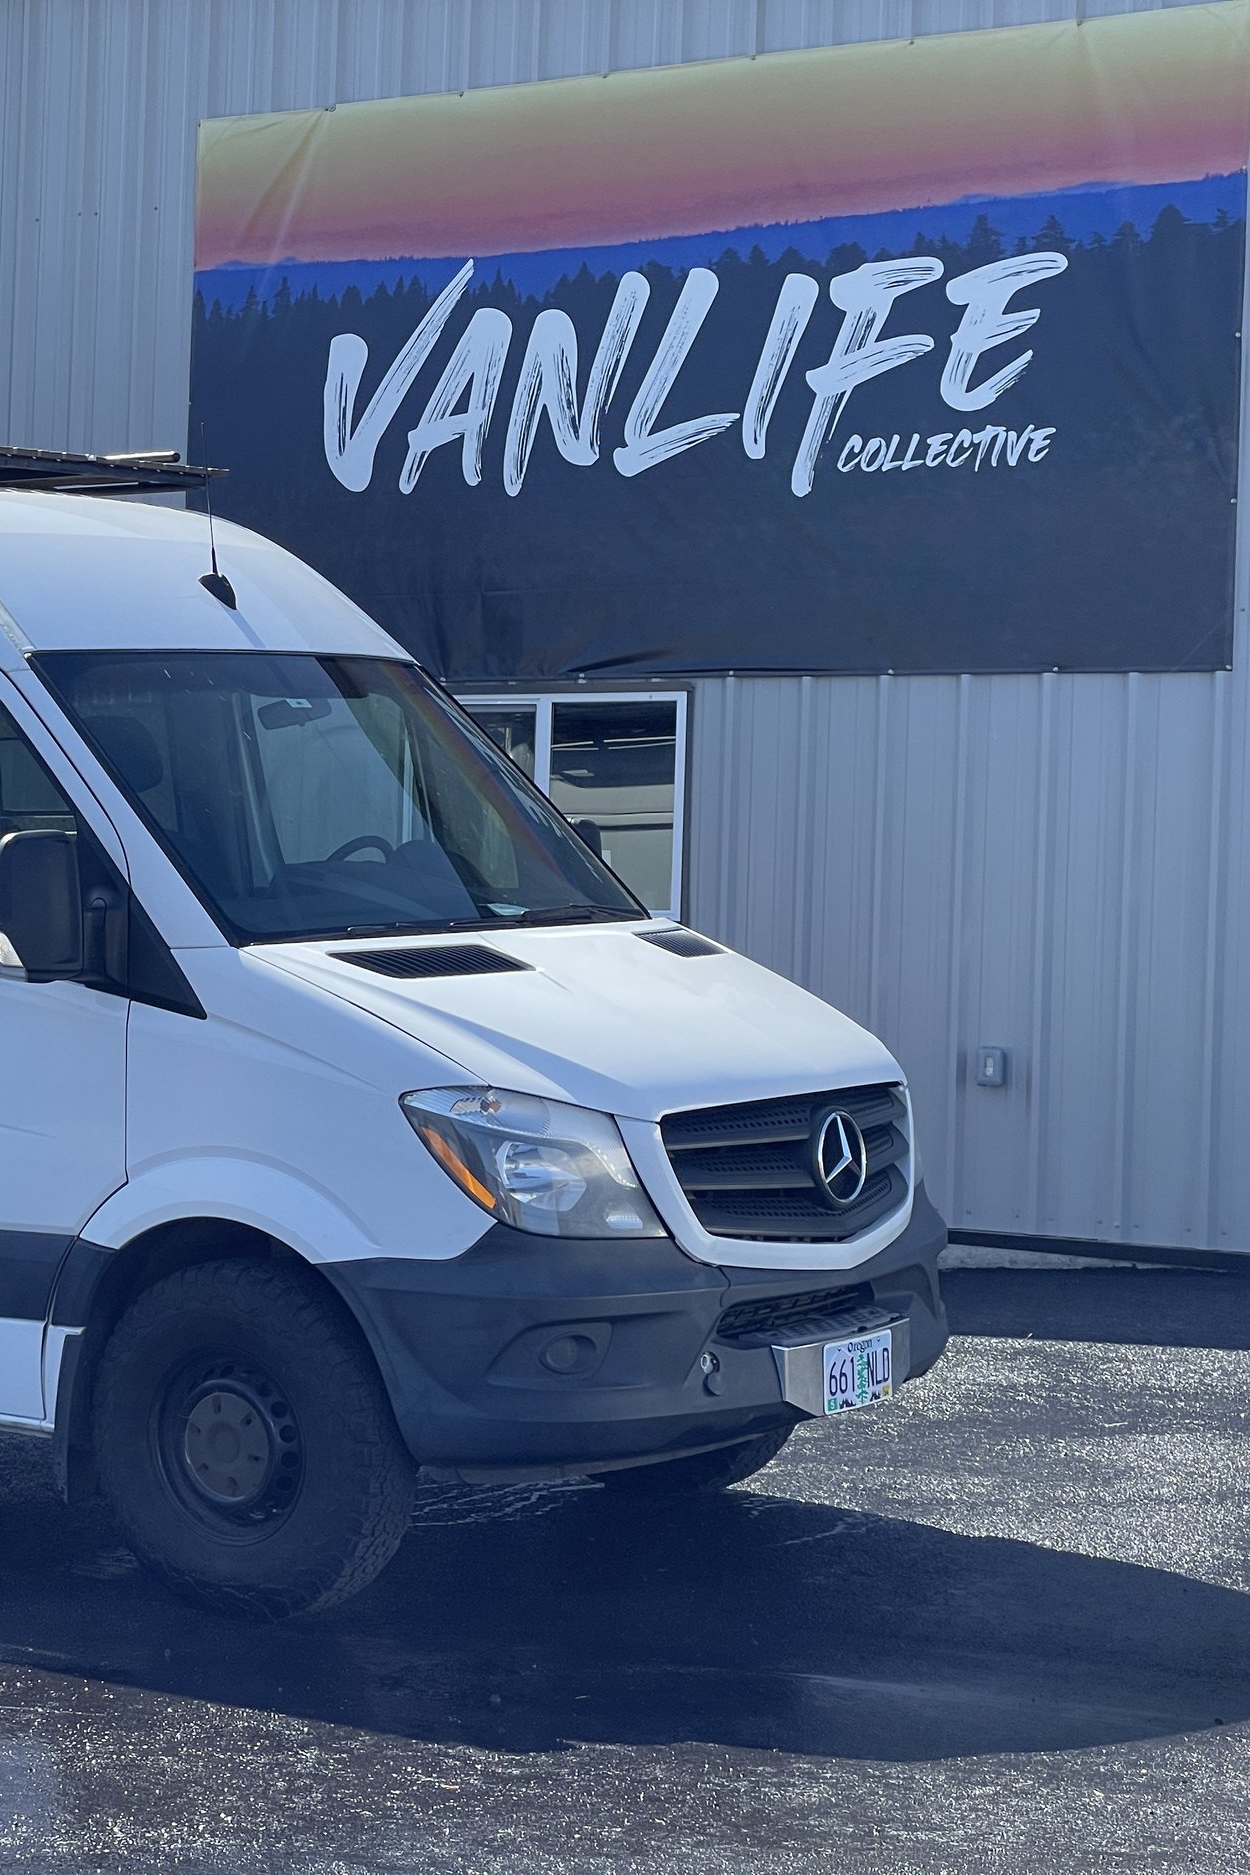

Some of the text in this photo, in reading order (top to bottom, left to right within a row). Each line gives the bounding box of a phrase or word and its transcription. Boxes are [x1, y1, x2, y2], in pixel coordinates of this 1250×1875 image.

[323, 251, 1068, 497] VANLIFE
[836, 424, 1057, 473] COLLECTIVE
[847, 1339, 873, 1353] Oregon
[829, 1347, 890, 1397] 661 NLD
